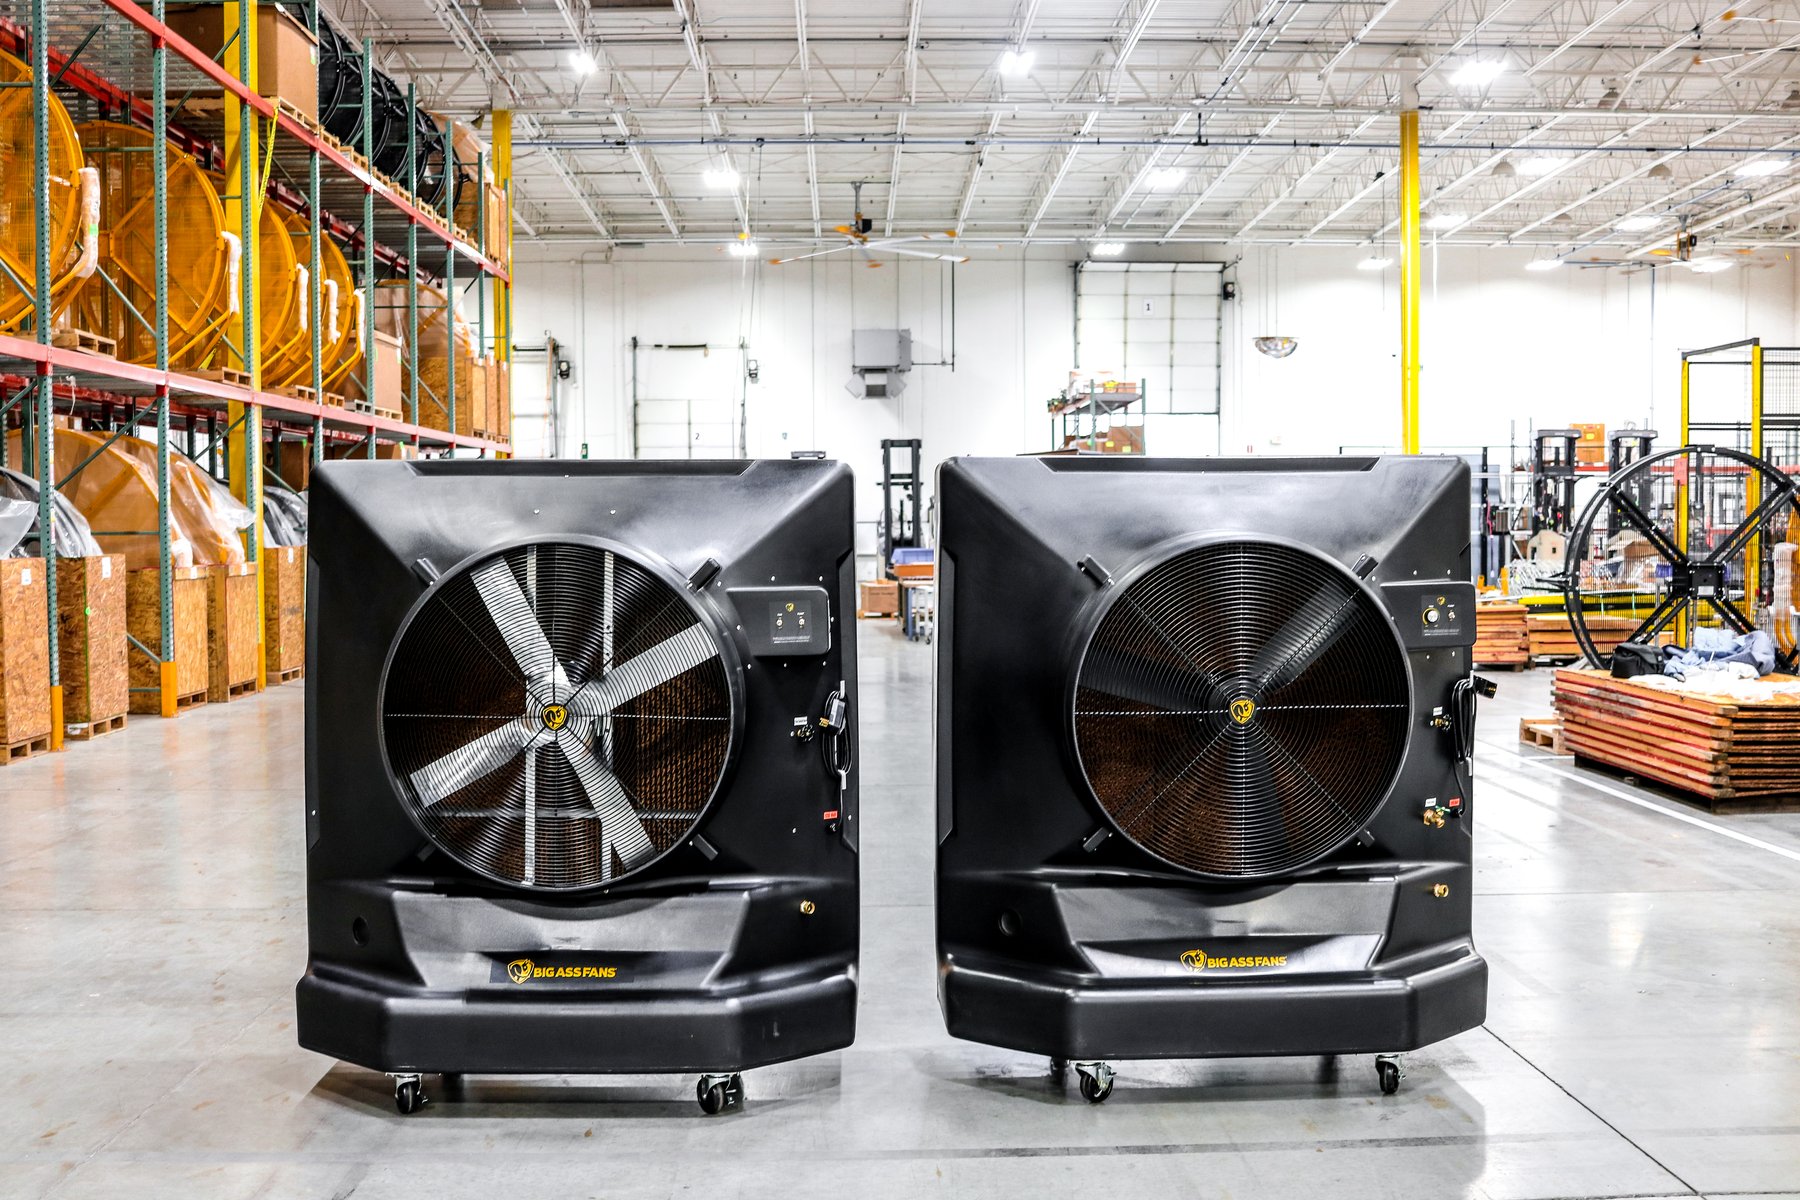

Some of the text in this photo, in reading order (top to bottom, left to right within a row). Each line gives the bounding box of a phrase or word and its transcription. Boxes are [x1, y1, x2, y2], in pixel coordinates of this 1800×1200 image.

[1207, 956, 1287, 969] BIG ASS FANS
[533, 967, 617, 978] BIG ASS FANS
